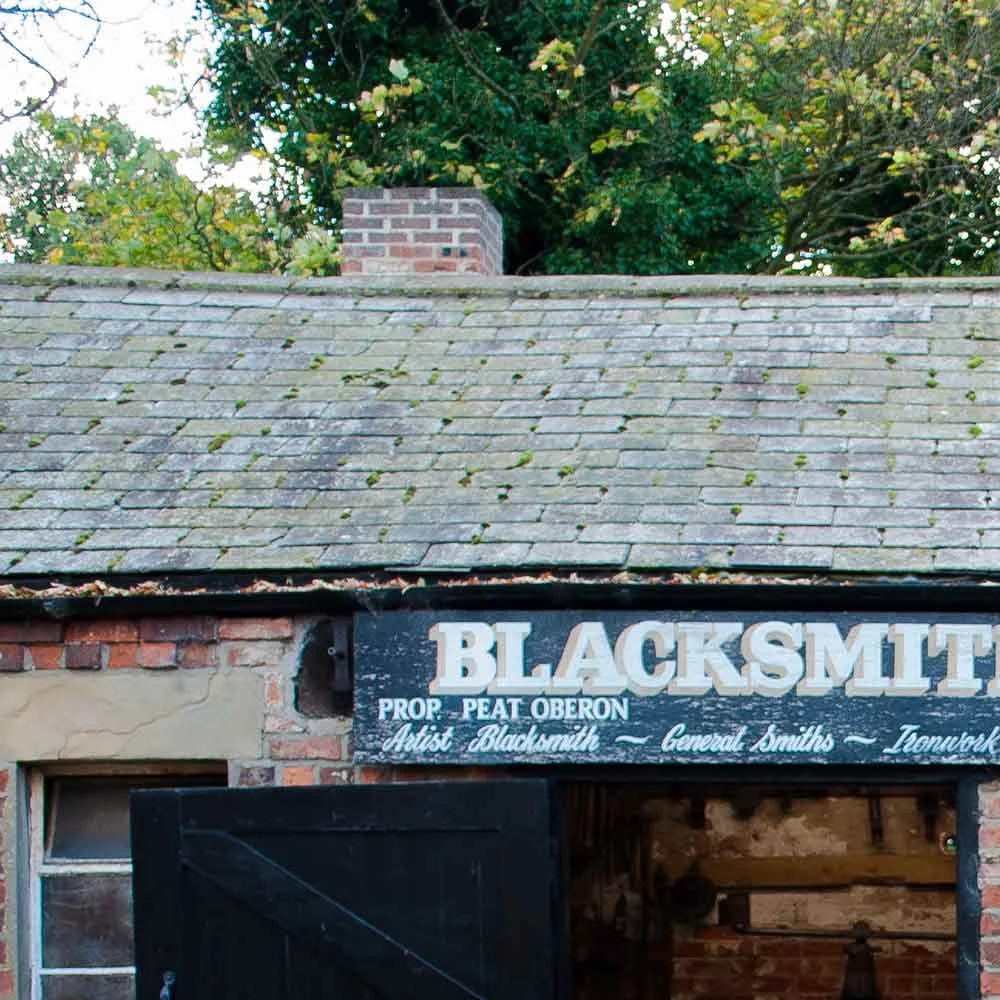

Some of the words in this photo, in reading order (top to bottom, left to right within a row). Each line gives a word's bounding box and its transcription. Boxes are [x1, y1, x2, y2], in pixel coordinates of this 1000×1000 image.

[462, 698, 521, 720] PEAT
[530, 697, 629, 721] OBERON
[382, 723, 454, 752] Artist
[467, 724, 600, 753] Blacksmith
[661, 723, 748, 752] General
[750, 724, 834, 752] Smiths
[884, 725, 1000, 754] Ironwork
